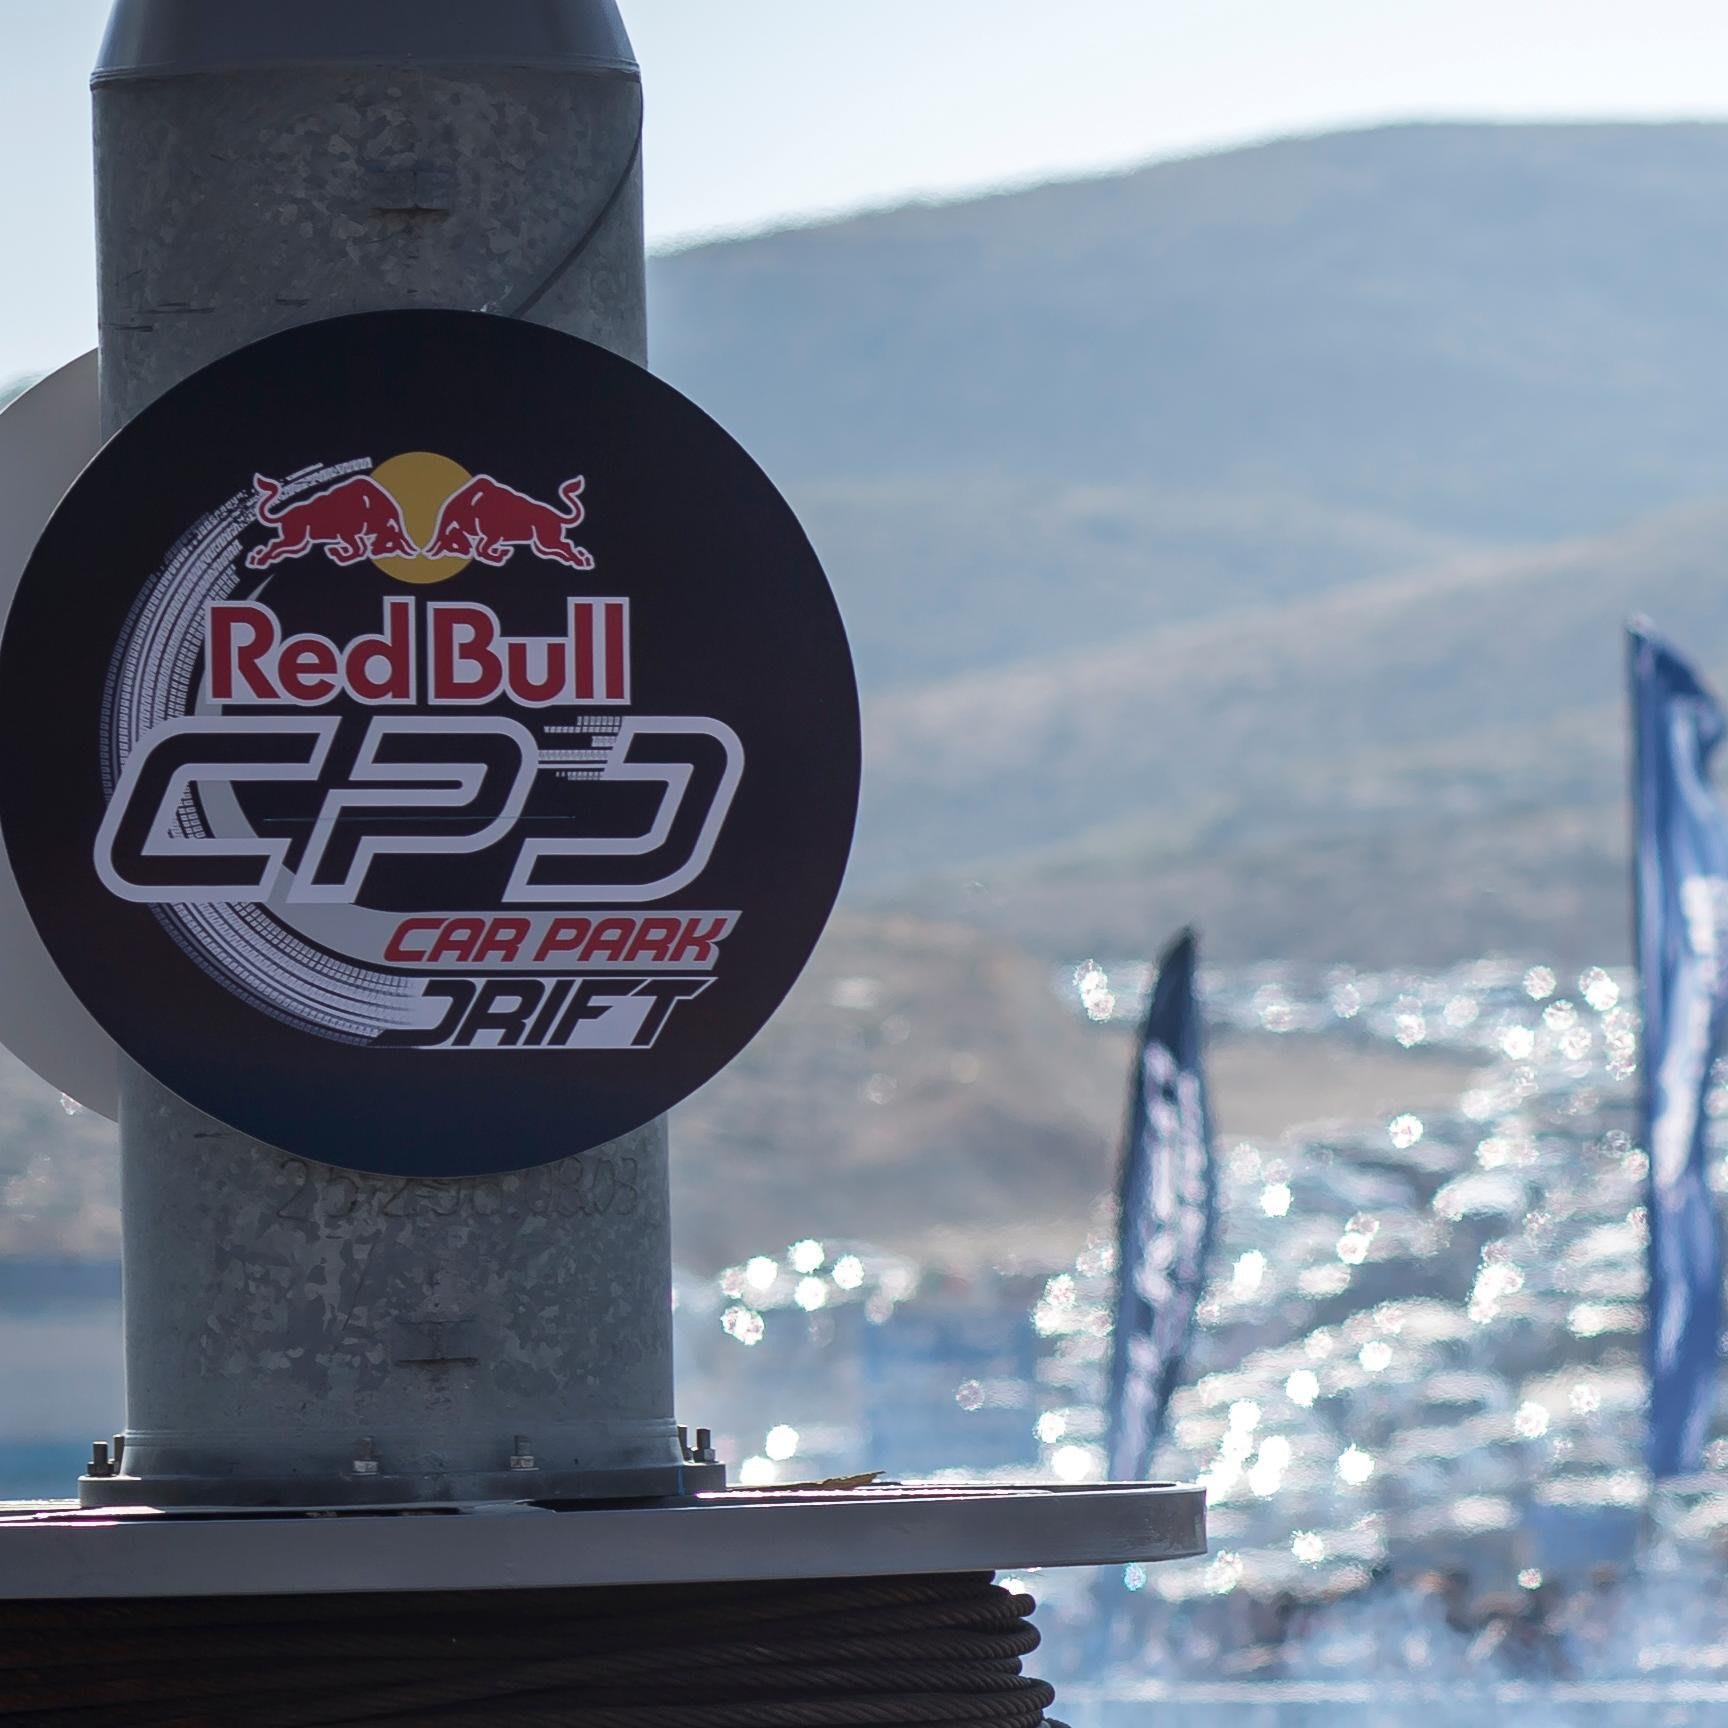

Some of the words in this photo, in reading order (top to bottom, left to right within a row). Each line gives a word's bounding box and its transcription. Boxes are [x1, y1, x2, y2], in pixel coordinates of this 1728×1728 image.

[206, 597, 416, 705] Red
[427, 596, 631, 708] Bull
[93, 716, 745, 903] CPD
[382, 916, 532, 963] CAR
[533, 916, 728, 963] PARK
[375, 976, 719, 1049] DRIFT
